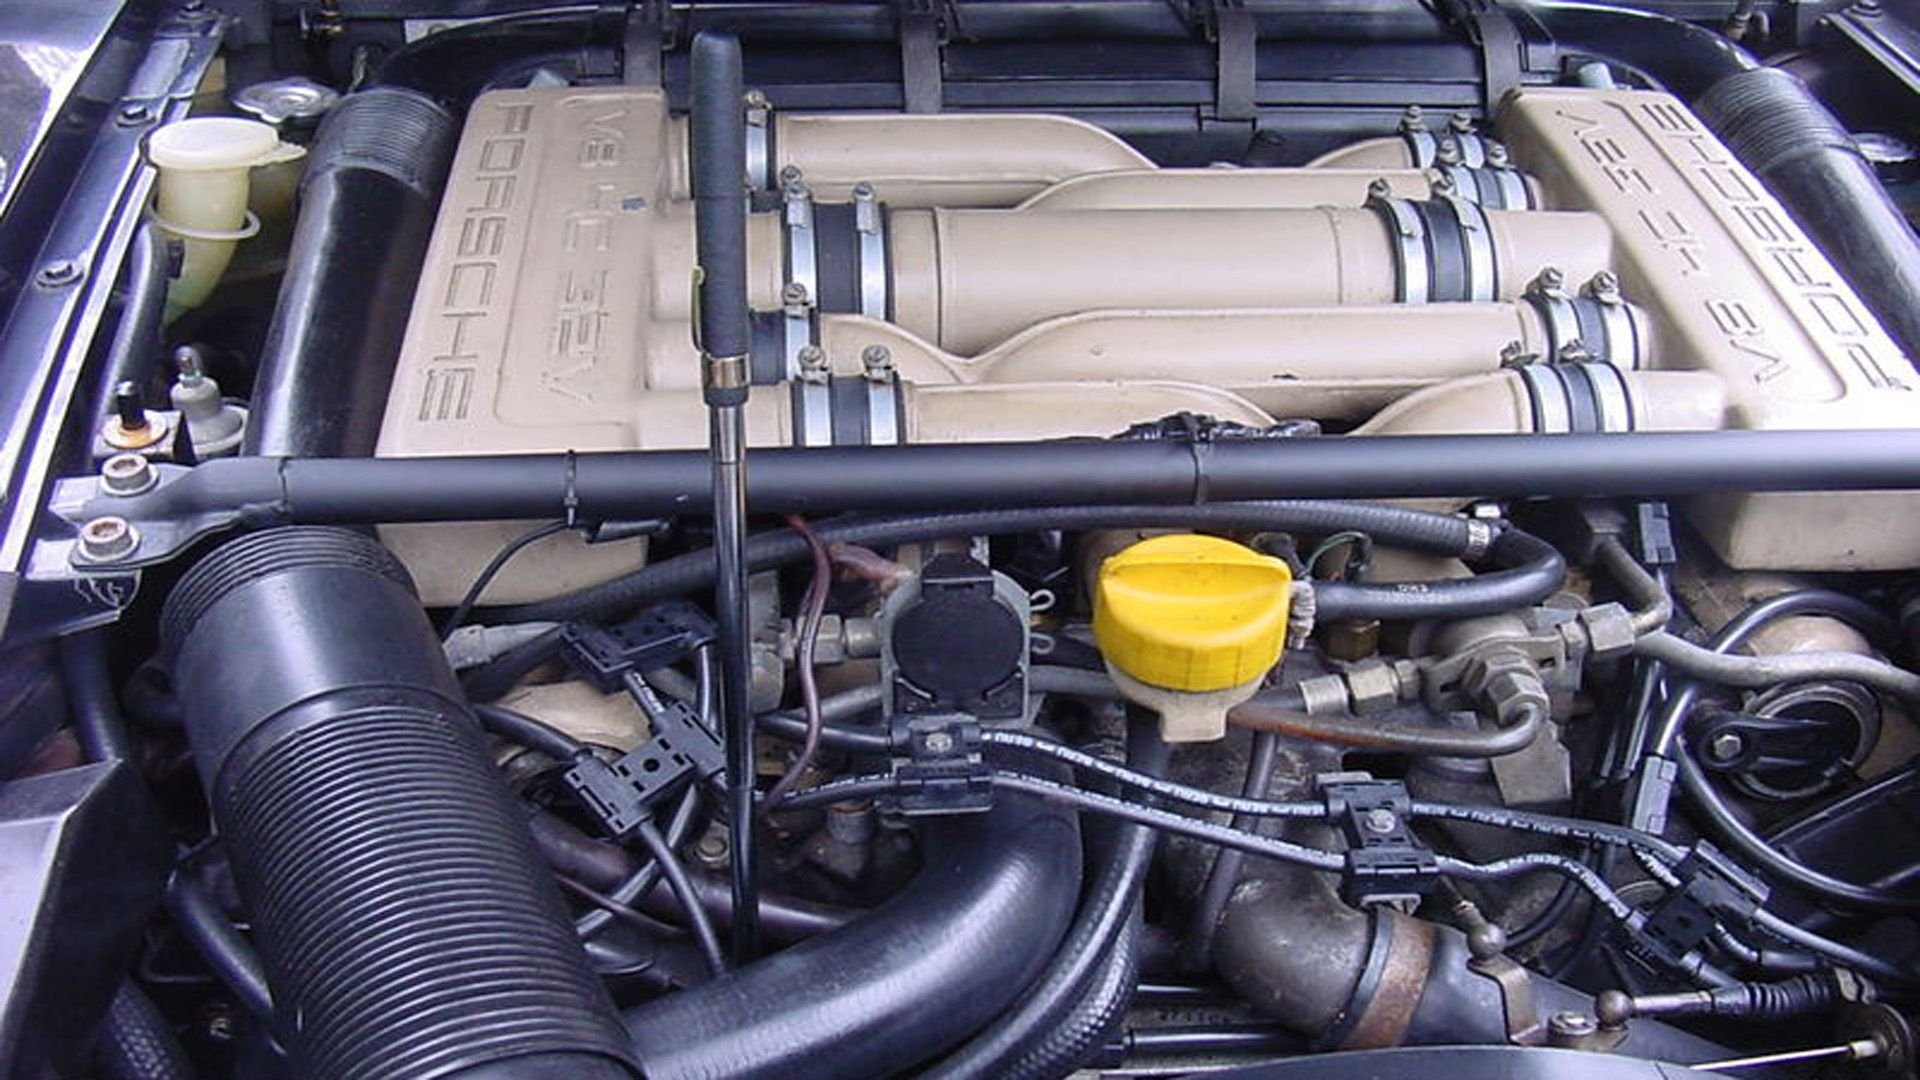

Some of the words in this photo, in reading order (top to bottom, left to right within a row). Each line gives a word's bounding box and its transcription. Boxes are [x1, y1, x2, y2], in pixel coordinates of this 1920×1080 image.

[579, 107, 631, 168] V8
[418, 104, 535, 422] PORSCHE
[1640, 103, 1913, 392] PORSCHE
[1704, 299, 1790, 385] V8
